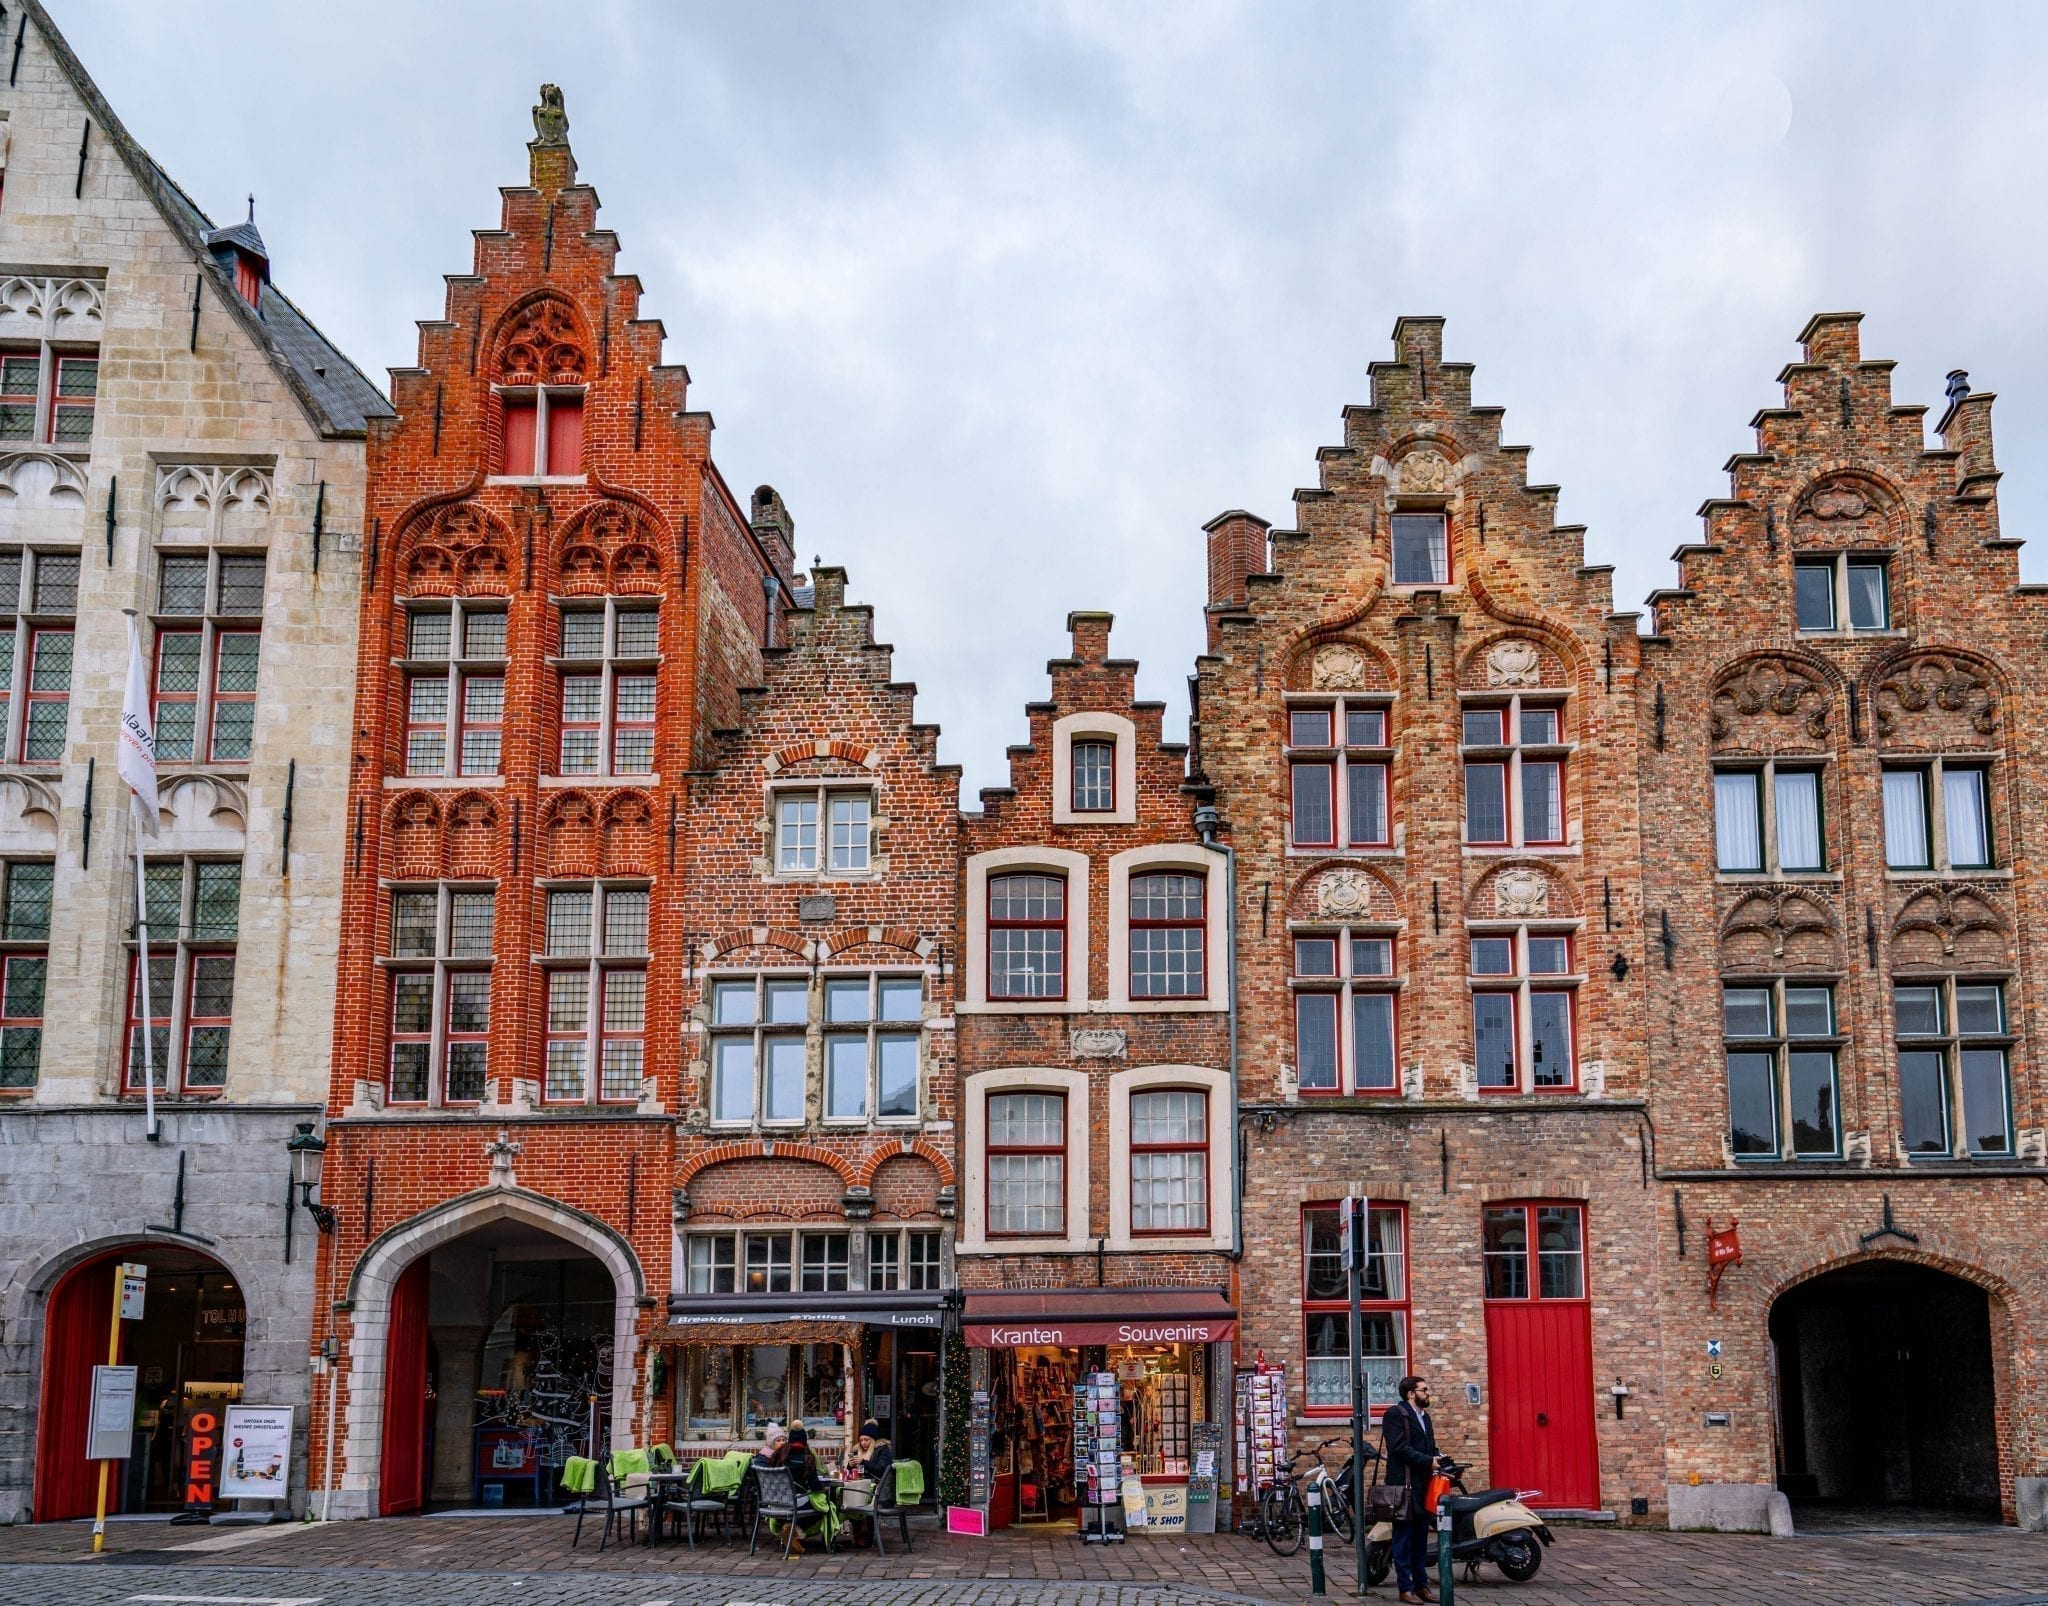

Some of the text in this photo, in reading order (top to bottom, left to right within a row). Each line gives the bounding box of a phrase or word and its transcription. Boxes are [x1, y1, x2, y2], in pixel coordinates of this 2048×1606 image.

[677, 1316, 744, 1324] Breakfast
[891, 1314, 934, 1324] Lunch
[990, 1324, 1209, 1345] Kranten Souvenirs
[1711, 1365, 1720, 1375] 6
[1615, 1376, 1622, 1386] 5
[186, 1413, 216, 1503] OPEN
[1160, 1515, 1185, 1526] SHOP
